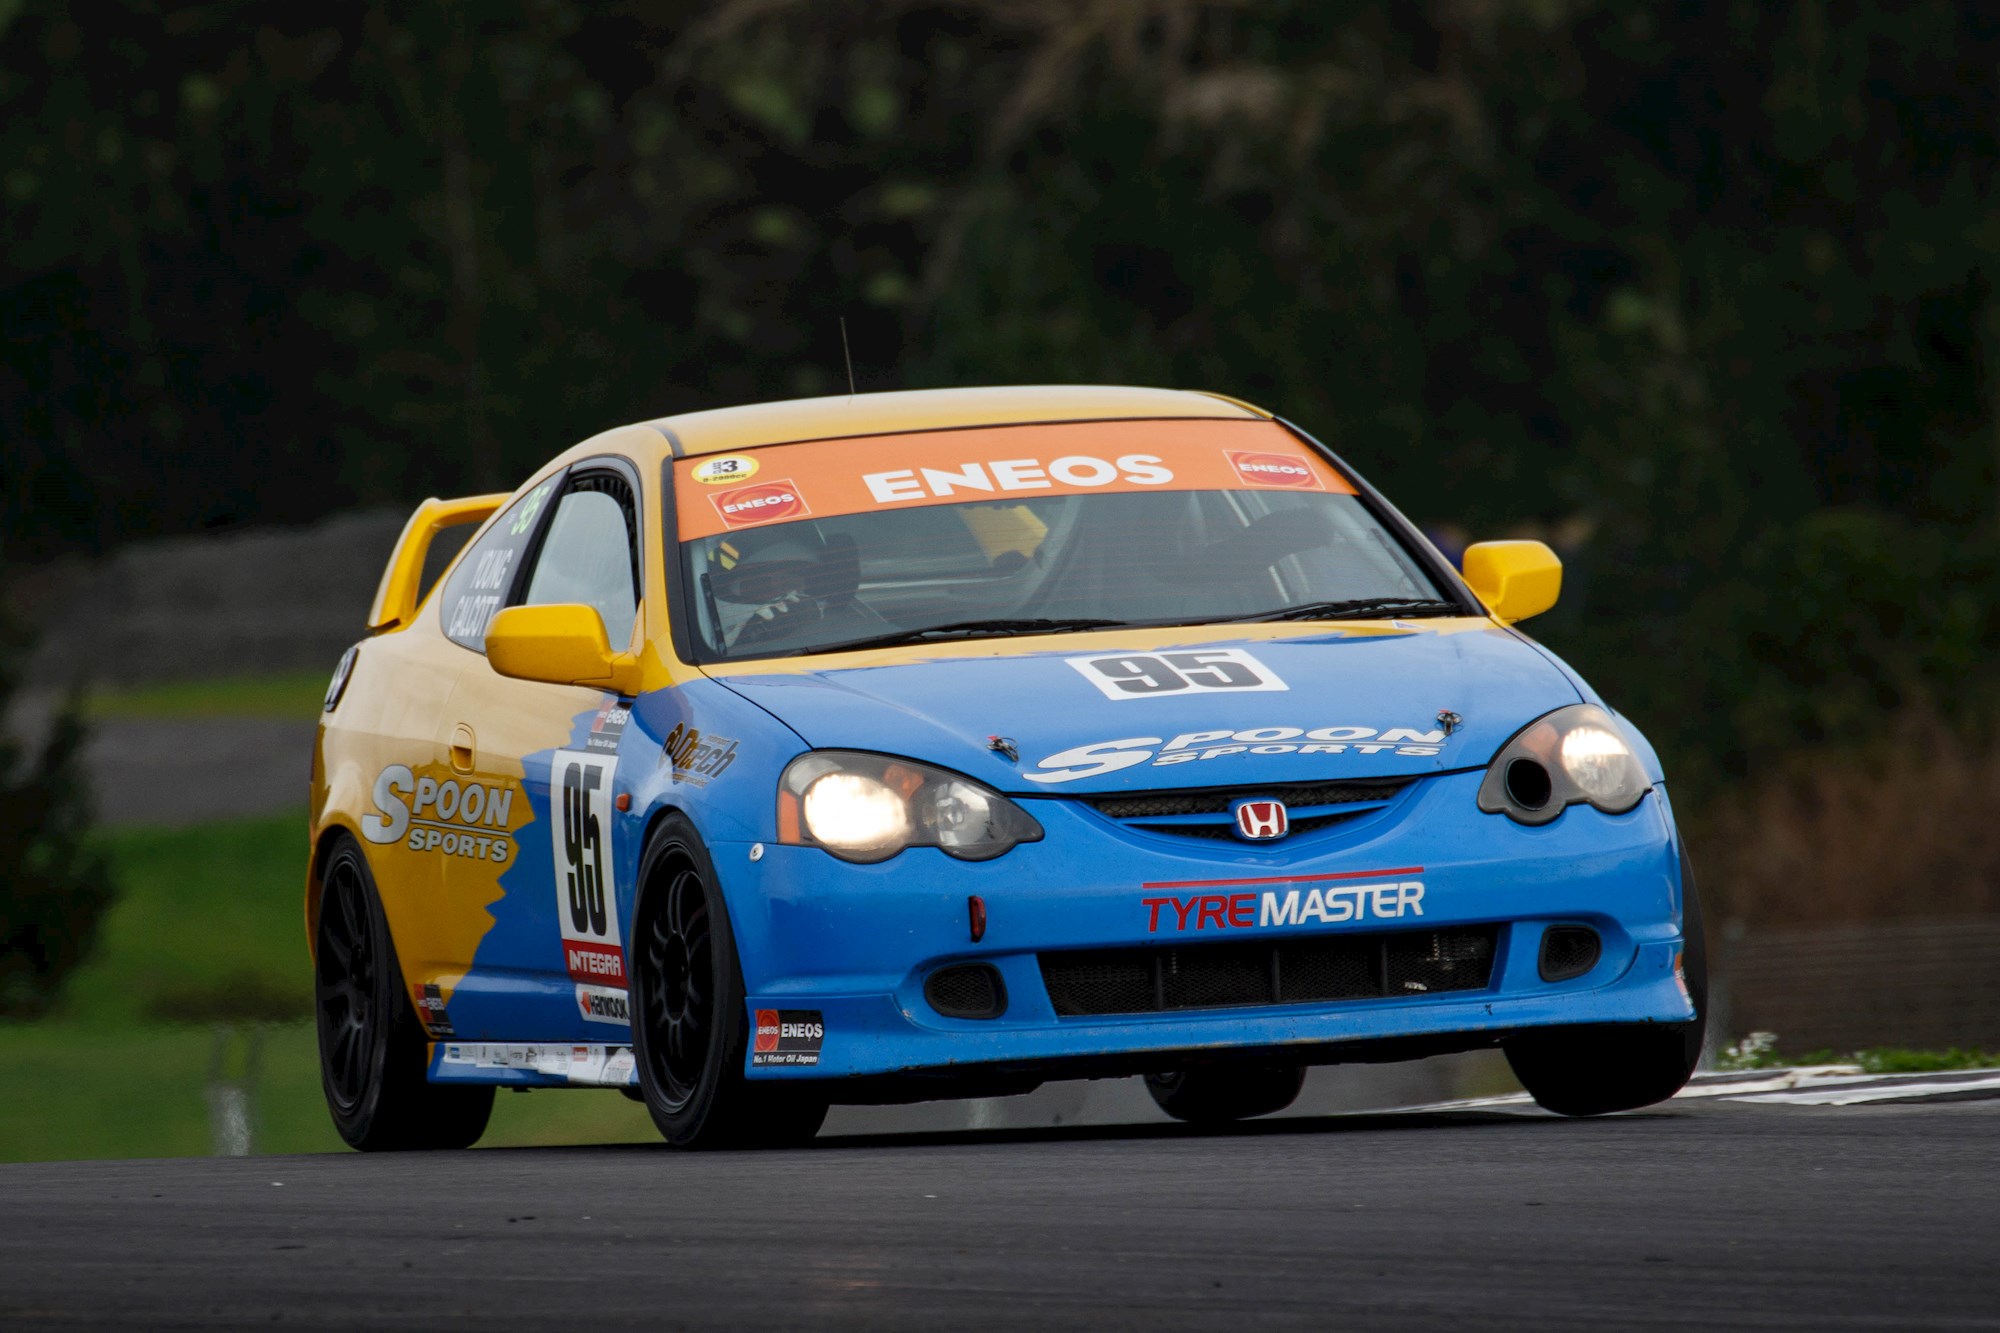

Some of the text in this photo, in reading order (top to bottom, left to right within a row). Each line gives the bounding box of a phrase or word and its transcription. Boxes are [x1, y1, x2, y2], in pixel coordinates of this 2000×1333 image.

[722, 460, 738, 473] 3
[862, 454, 1174, 504] ENEOS
[1238, 463, 1309, 475] ENEOS
[723, 493, 795, 514] ENEOS
[1089, 652, 1264, 693] 95
[1022, 727, 1448, 784] SPOON
[1151, 744, 1440, 767] SPORTS
[361, 764, 513, 845] SPOON
[408, 828, 509, 863] SPORTS
[563, 762, 607, 936] 95
[781, 1023, 823, 1039] ENEOS
